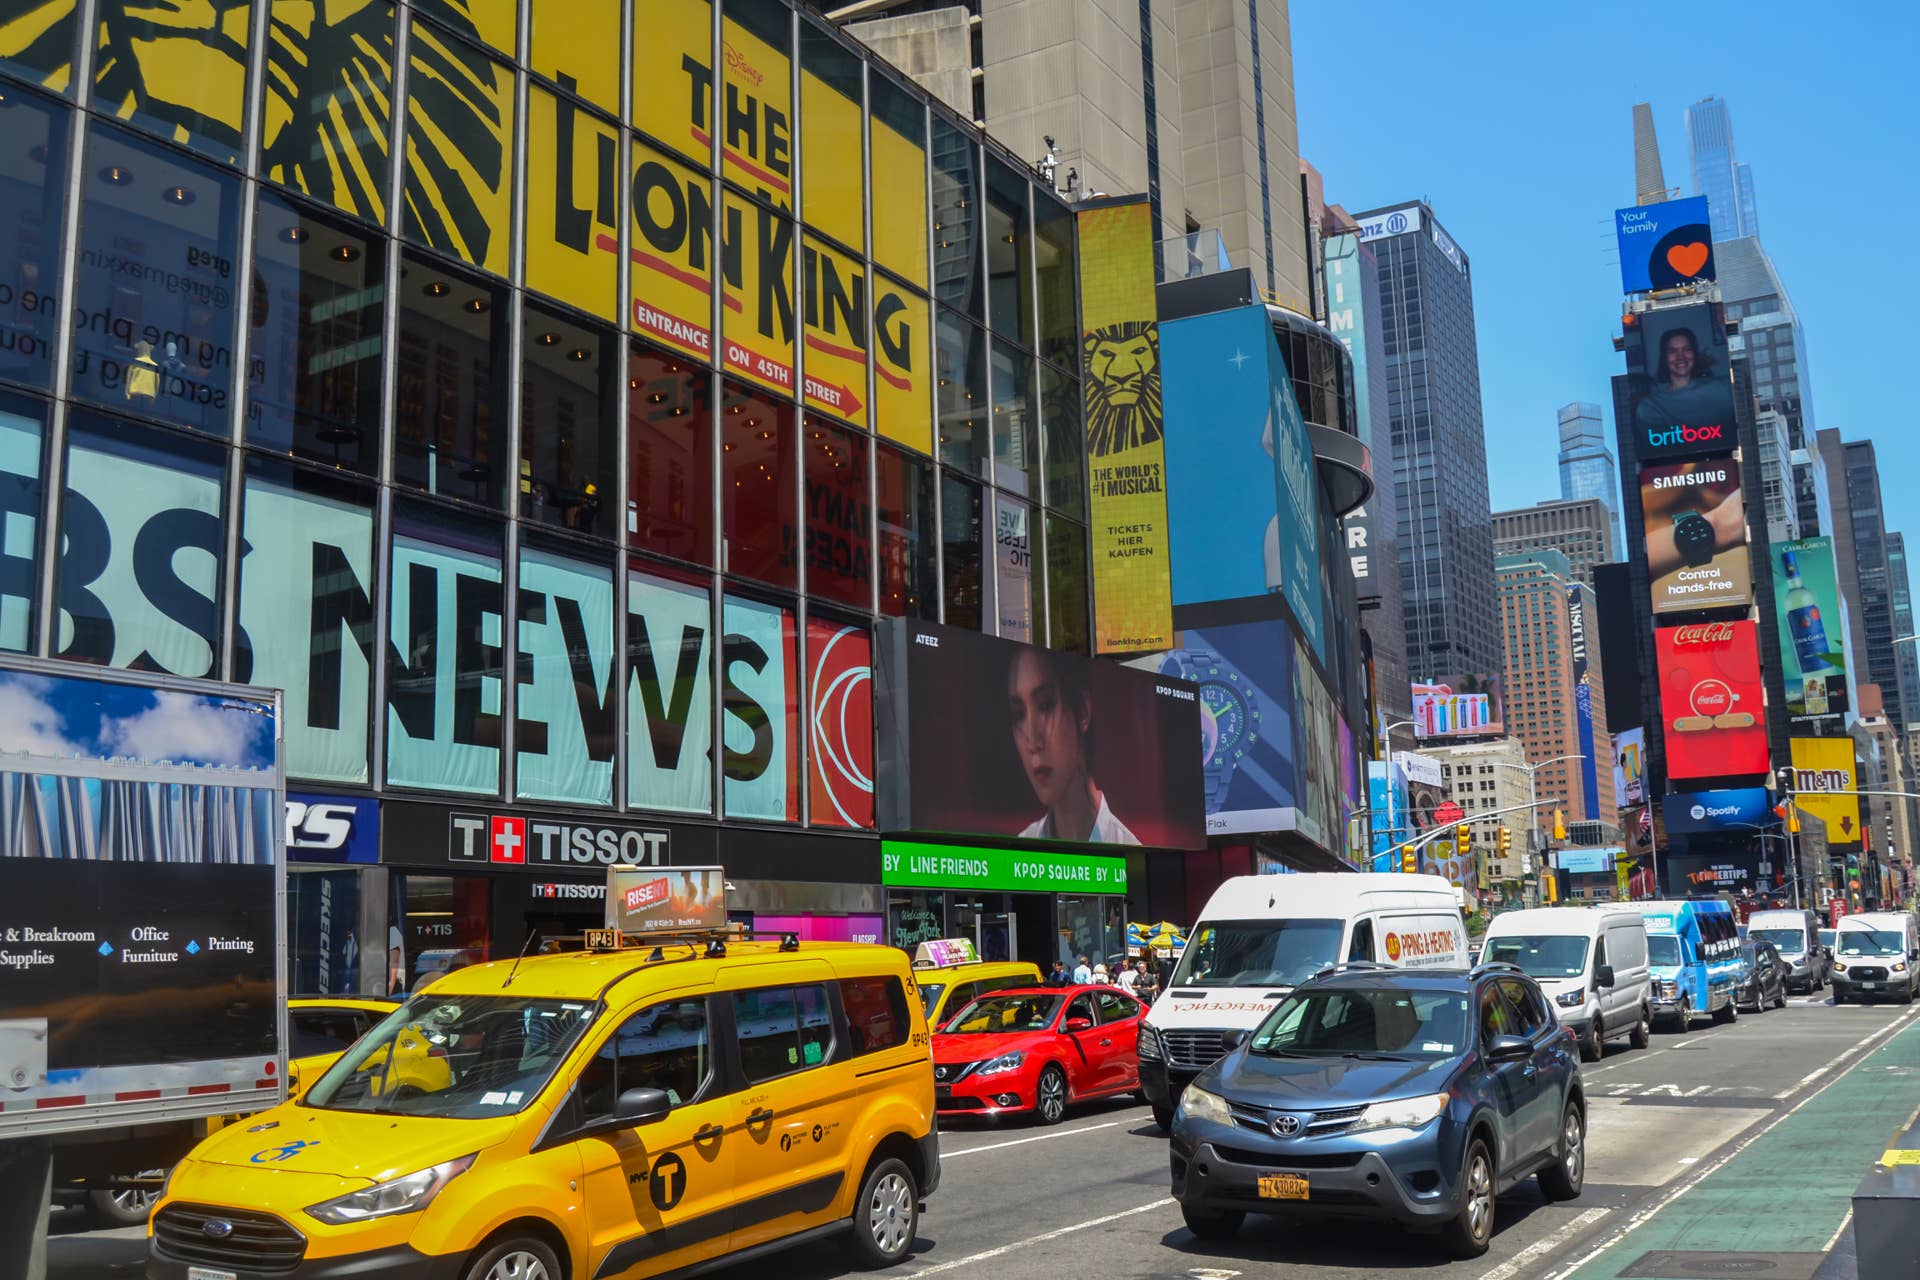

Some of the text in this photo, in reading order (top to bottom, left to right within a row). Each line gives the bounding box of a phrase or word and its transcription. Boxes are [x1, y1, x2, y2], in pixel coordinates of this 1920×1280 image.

[682, 53, 789, 178] THE
[555, 69, 912, 373] LION KING
[1621, 211, 1647, 222] Your
[1622, 221, 1658, 234] family
[638, 305, 710, 350] ENTRANCE
[728, 346, 788, 384] ON 45TH
[805, 379, 840, 407] STREET
[1648, 424, 1722, 446] britbox
[1093, 464, 1160, 482] THE WORLD'S
[1653, 470, 1726, 488] SAMSUNG
[1108, 477, 1162, 496] MUSICAL
[1108, 524, 1152, 536] TICKETS
[1118, 536, 1143, 546] HIER
[1109, 548, 1153, 558] KAUFEN
[1678, 568, 1720, 581] Control
[1668, 580, 1732, 595] hands-free
[916, 633, 938, 648] ATEEZ
[1107, 636, 1163, 647] lionking.com
[1674, 622, 1735, 645] Coca-Cola
[307, 541, 773, 782] NEWS
[1156, 686, 1195, 700] KPOP SQUARE
[1706, 805, 1740, 817] Spotify
[532, 824, 668, 866] TISSOT
[883, 854, 900, 872] BY
[910, 856, 938, 874] LINE
[940, 858, 988, 876] FRIENDS
[1014, 862, 1044, 878] KPOP
[1049, 864, 1090, 880] SQUARE
[1096, 867, 1108, 882] BY
[554, 884, 606, 898] TISSOT
[6, 927, 95, 942] & Breakroom
[131, 926, 169, 941] Office
[852, 934, 876, 944] FLAGSHIP
[896, 922, 941, 948] New York
[209, 936, 254, 953] Printing
[1401, 932, 1424, 957] PIPING
[1430, 930, 1454, 954] HEATING
[0, 950, 54, 969] Supplies
[122, 948, 178, 962] Furniture
[630, 1172, 648, 1184] NYC
[657, 1162, 678, 1204] T
